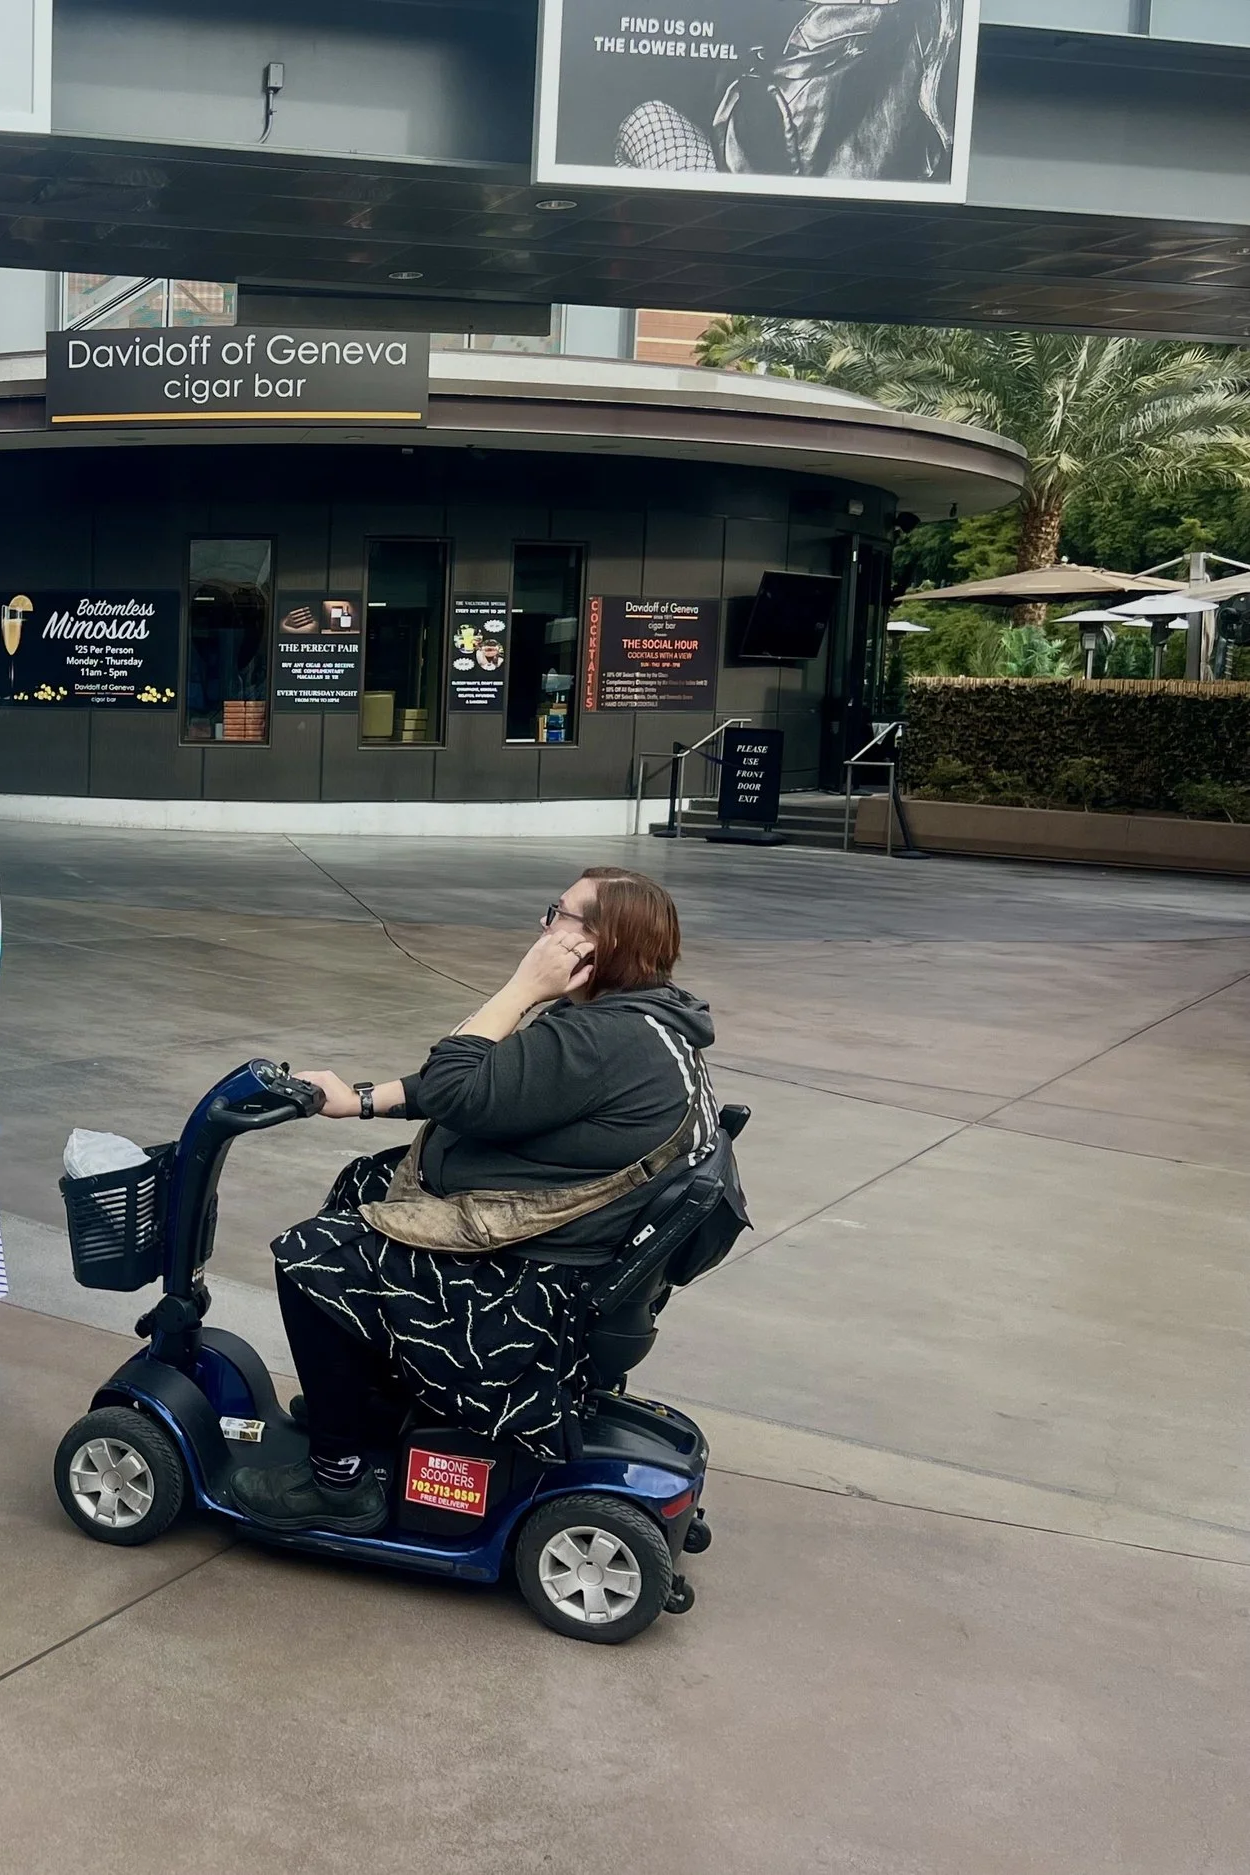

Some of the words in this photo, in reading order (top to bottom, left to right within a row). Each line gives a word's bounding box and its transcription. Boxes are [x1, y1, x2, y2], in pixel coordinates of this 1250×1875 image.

[620, 17, 659, 34] FIND
[663, 18, 685, 36] US
[689, 19, 714, 37] ON
[594, 36, 625, 54] THE
[629, 38, 687, 58] LOWER
[689, 41, 738, 60] LEVEL
[68, 335, 211, 369] Davidoff
[221, 334, 256, 365] of
[266, 335, 407, 366] Geneva
[163, 373, 243, 404] cigar
[254, 373, 306, 398] bar
[77, 599, 155, 616] Bottomless
[625, 602, 659, 612] Davidoff
[661, 602, 669, 613] of
[670, 603, 699, 614] Geneva
[42, 611, 150, 639] Mimosas
[648, 621, 664, 631] cigar
[665, 621, 676, 630] bar
[75, 645, 88, 654] $25
[90, 645, 103, 654] Per
[105, 645, 134, 654] Person
[279, 644, 299, 652] THE
[338, 644, 359, 653] PAIR
[622, 639, 640, 649] THE
[642, 640, 672, 649] SOCIAL
[674, 640, 698, 650] HOUR
[586, 601, 598, 708] COCKTAILS
[66, 656, 99, 667] Monday
[105, 656, 143, 668] Thursday
[80, 668, 102, 677] 11am
[109, 668, 128, 679] 5pm
[736, 745, 768, 753] PLEASE
[743, 757, 759, 766] USE
[736, 770, 765, 778] FRONT
[737, 782, 761, 791] DOOR
[738, 794, 759, 803] EXIT
[420, 1467, 474, 1488] SCOOTERS
[420, 1493, 437, 1503] FREE
[438, 1497, 469, 1509] DELIVERY
